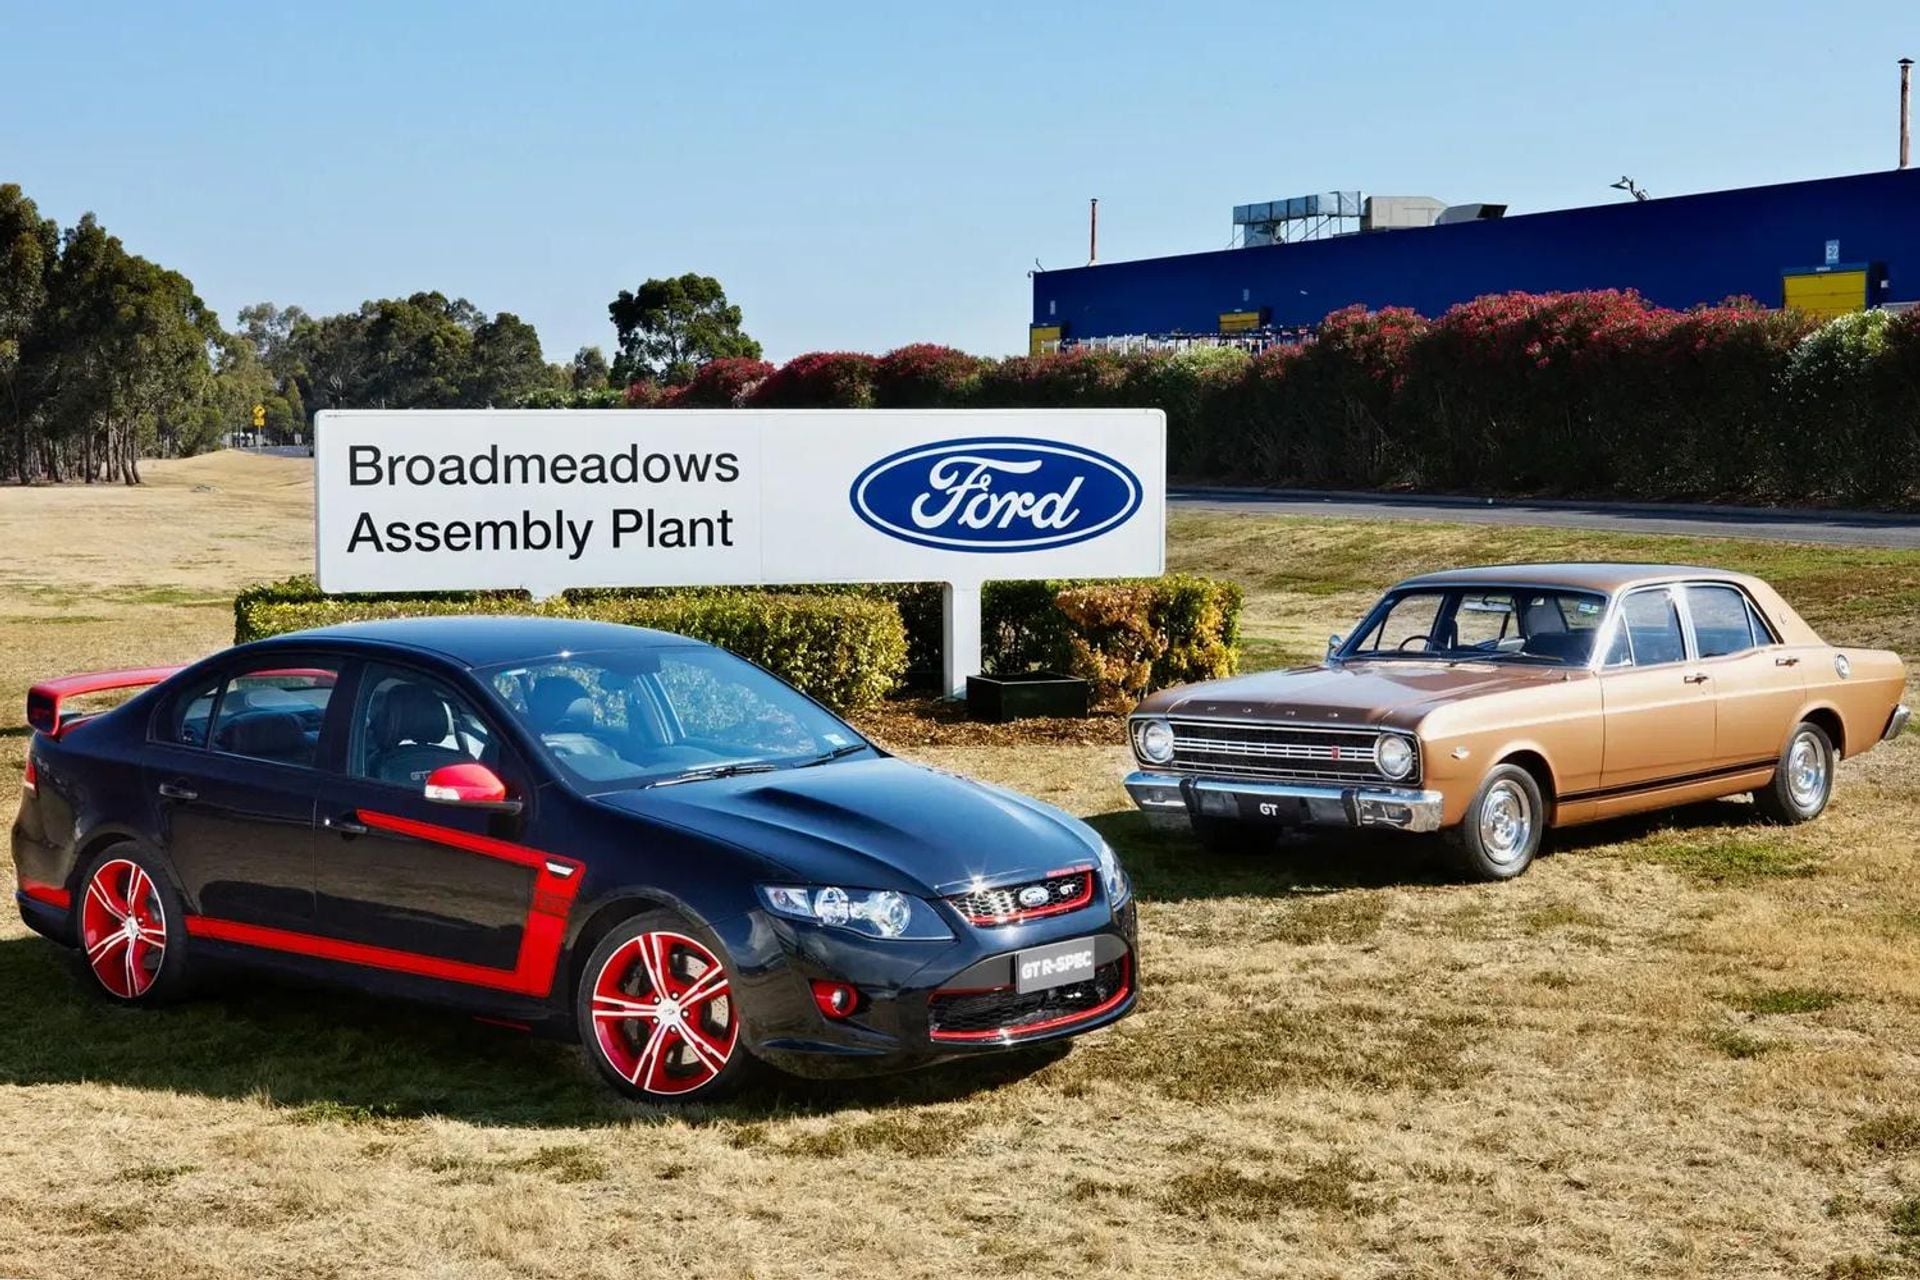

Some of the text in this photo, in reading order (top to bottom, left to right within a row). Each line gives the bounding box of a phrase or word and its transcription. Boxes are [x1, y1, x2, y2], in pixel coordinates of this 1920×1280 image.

[349, 444, 739, 485] Broadmeadows
[912, 457, 1083, 528] Ford
[347, 509, 733, 560] Assembly Plant
[1260, 802, 1278, 816] GT
[1060, 883, 1076, 895] GT
[1022, 950, 1092, 980] GT R-SPEC
